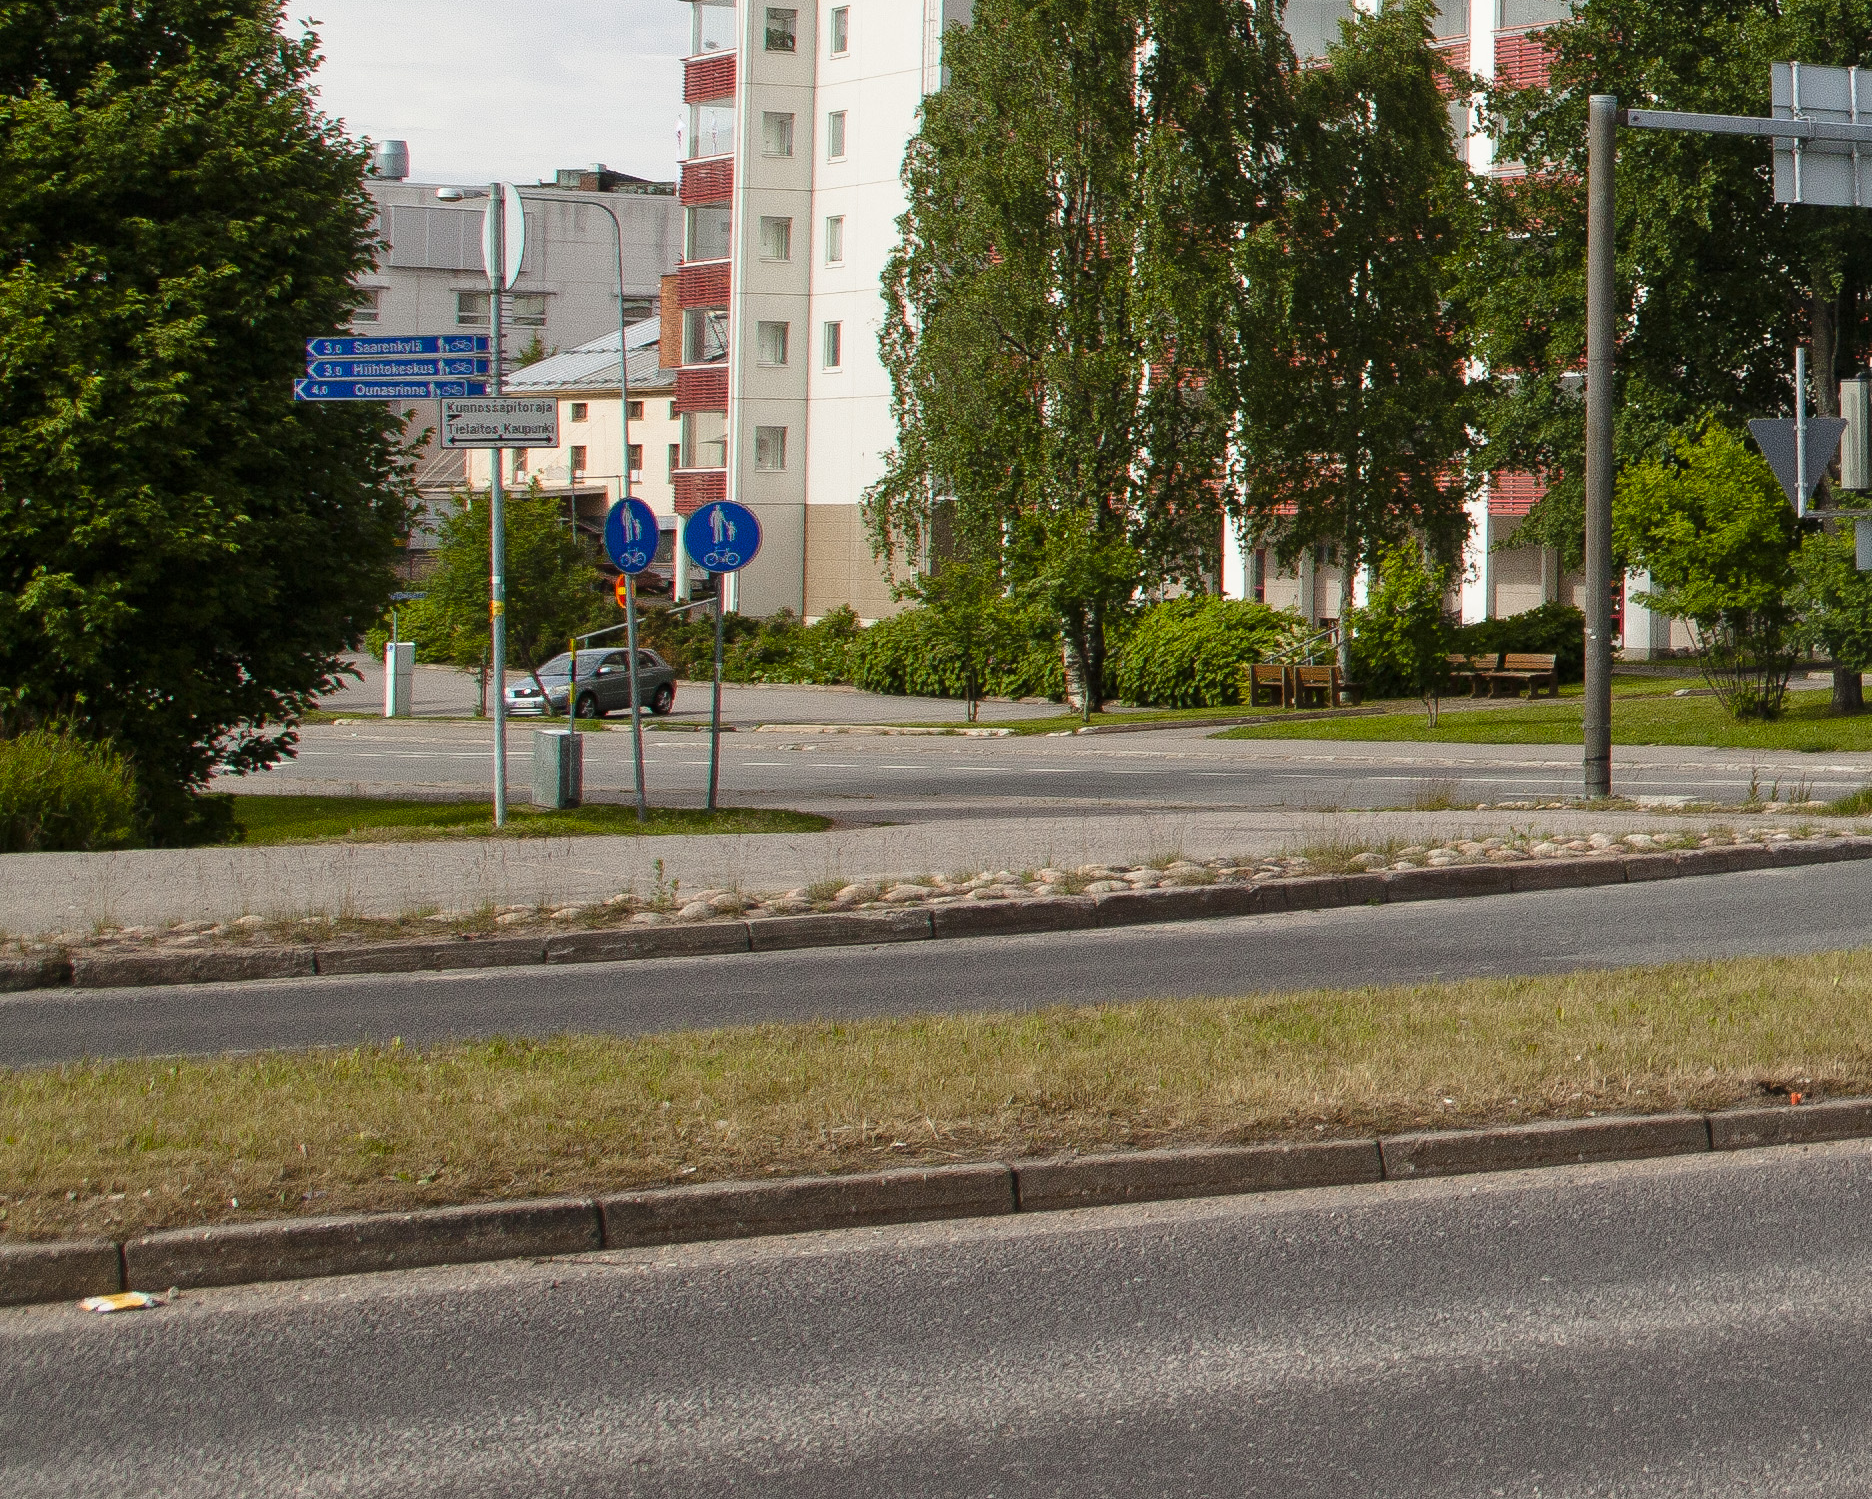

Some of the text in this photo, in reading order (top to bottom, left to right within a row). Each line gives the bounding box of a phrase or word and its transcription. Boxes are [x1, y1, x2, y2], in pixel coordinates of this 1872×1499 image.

[353, 339, 423, 354] Saarenkylä
[353, 362, 435, 376] Hiihtokeskus
[354, 383, 427, 396] Ounasrinne
[447, 401, 553, 415] Kunnossapitoraja
[446, 422, 555, 436] Tielaitos Kaupunki
